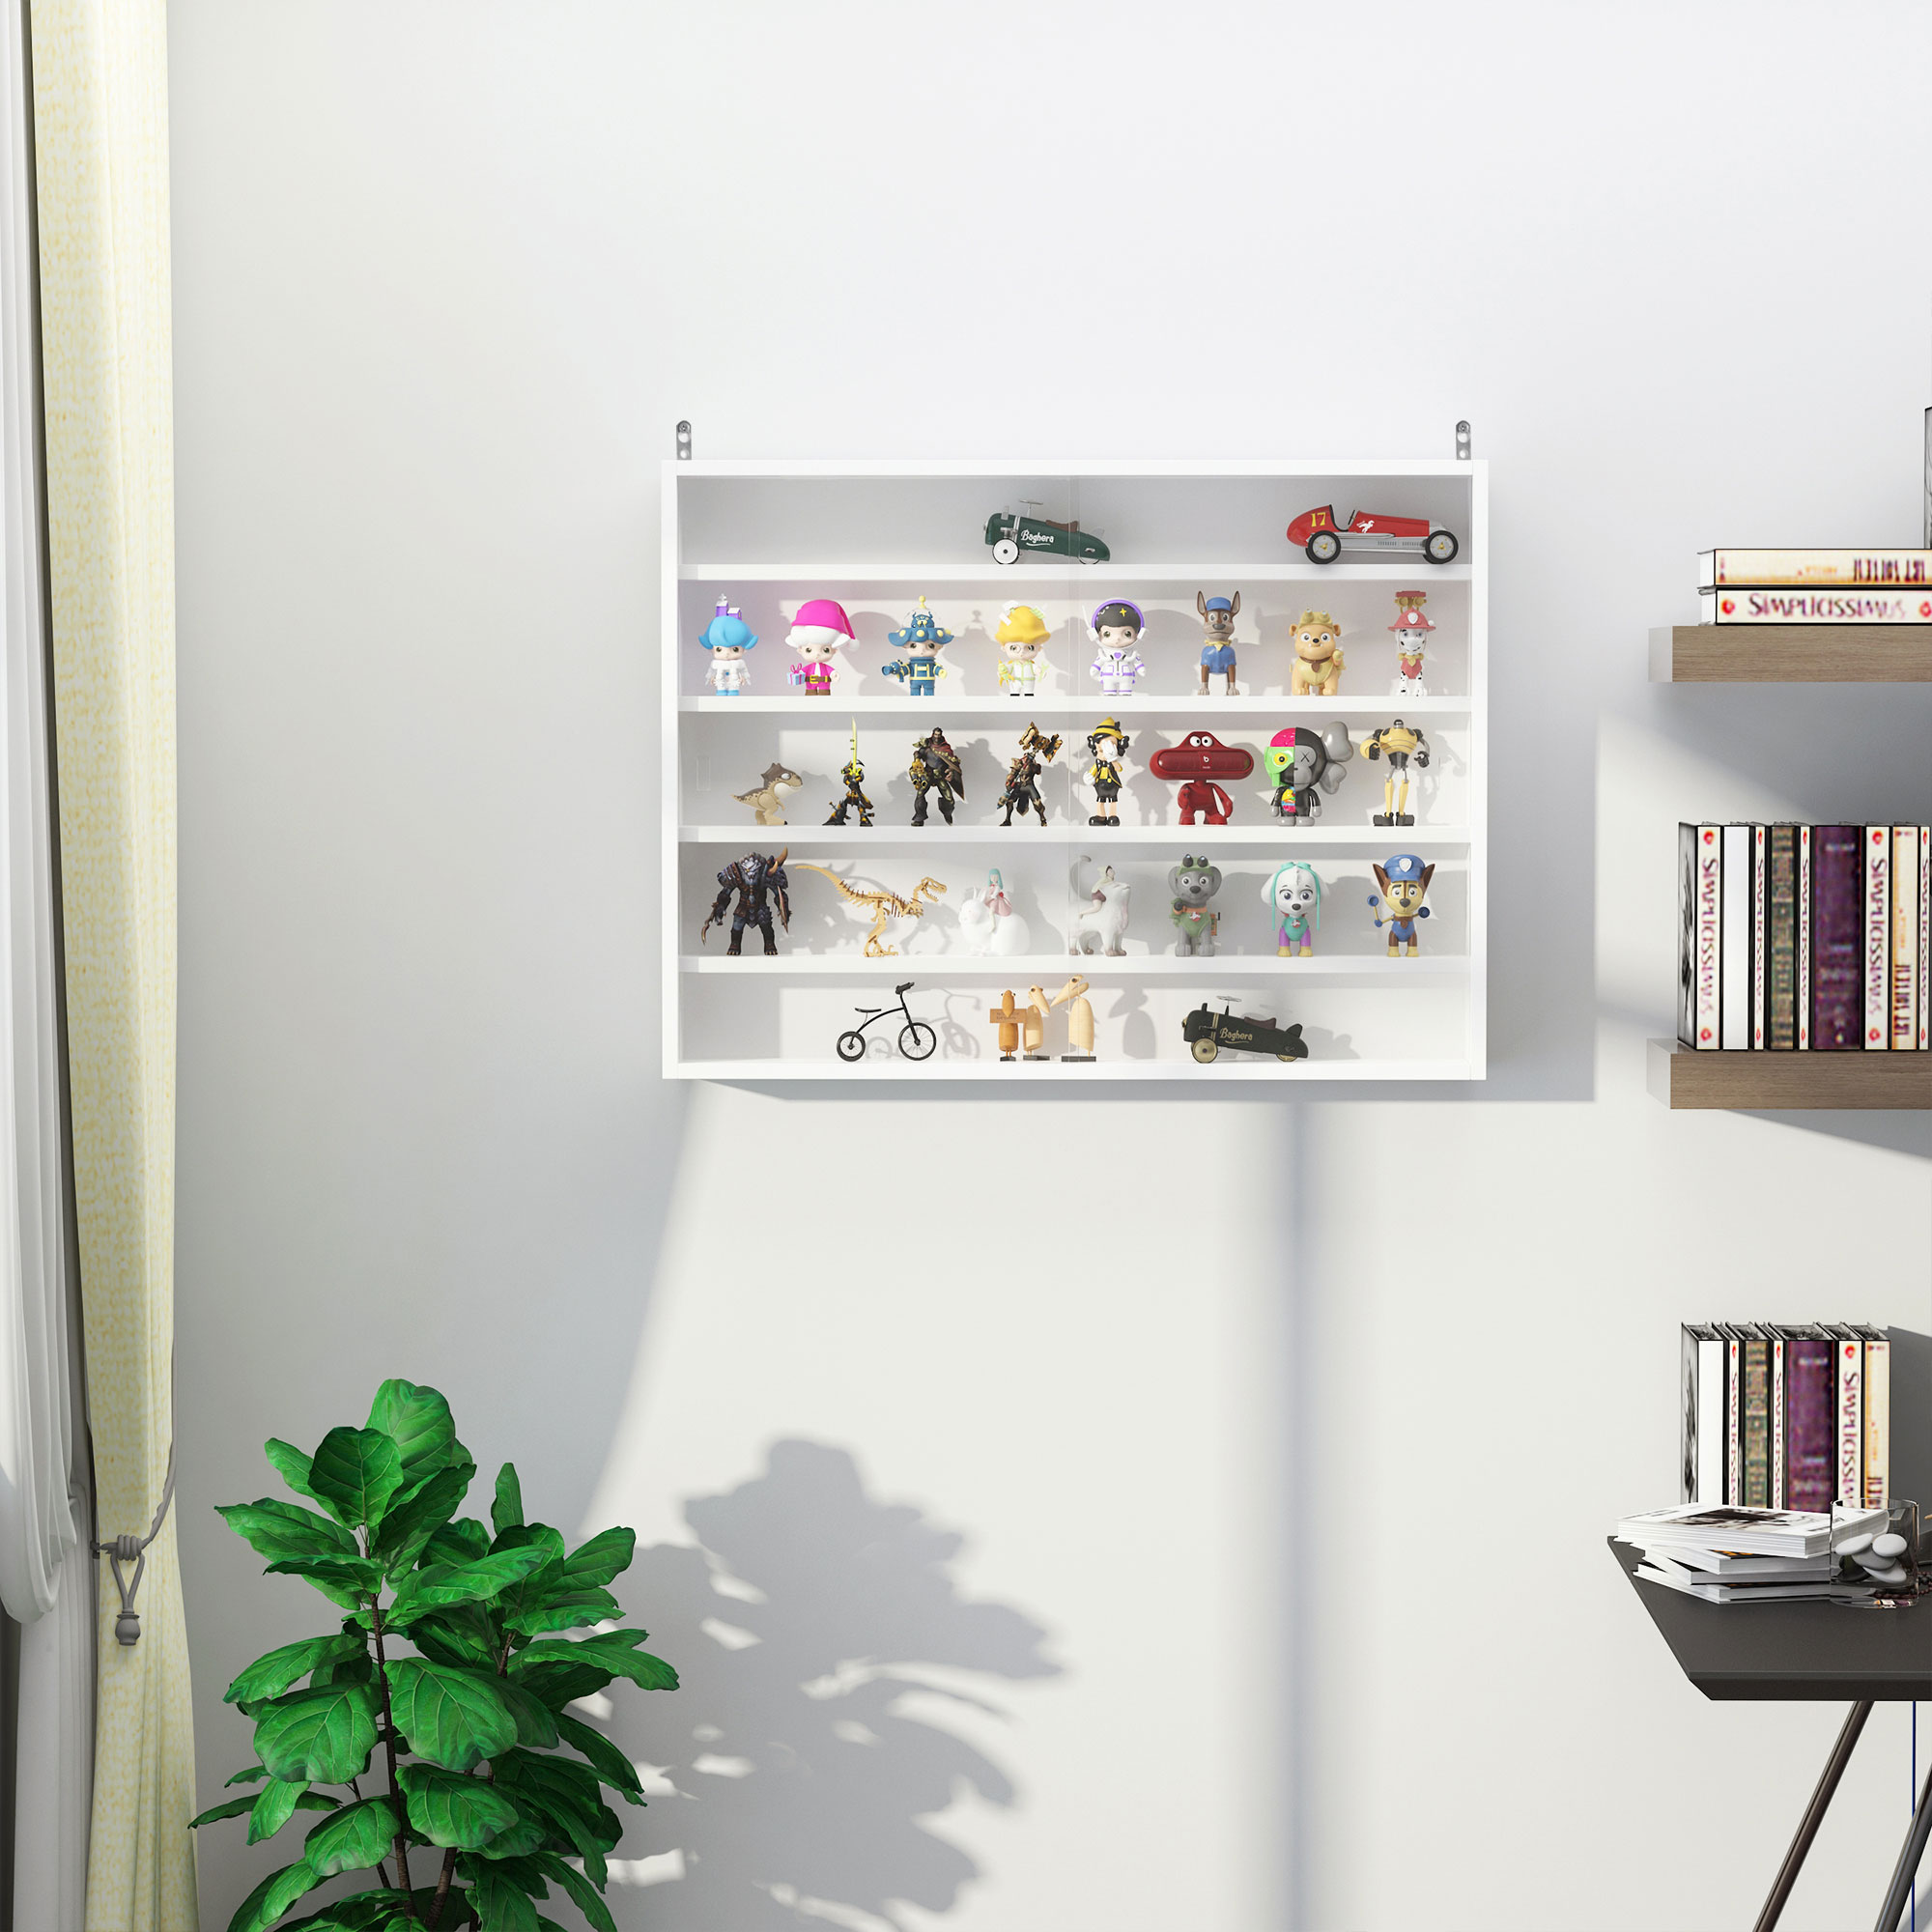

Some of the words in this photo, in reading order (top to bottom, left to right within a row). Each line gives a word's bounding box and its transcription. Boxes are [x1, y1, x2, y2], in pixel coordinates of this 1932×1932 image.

[1311, 512, 1326, 526] 17
[1020, 529, 1054, 543] Baghera
[1219, 1027, 1253, 1040] Baghera
